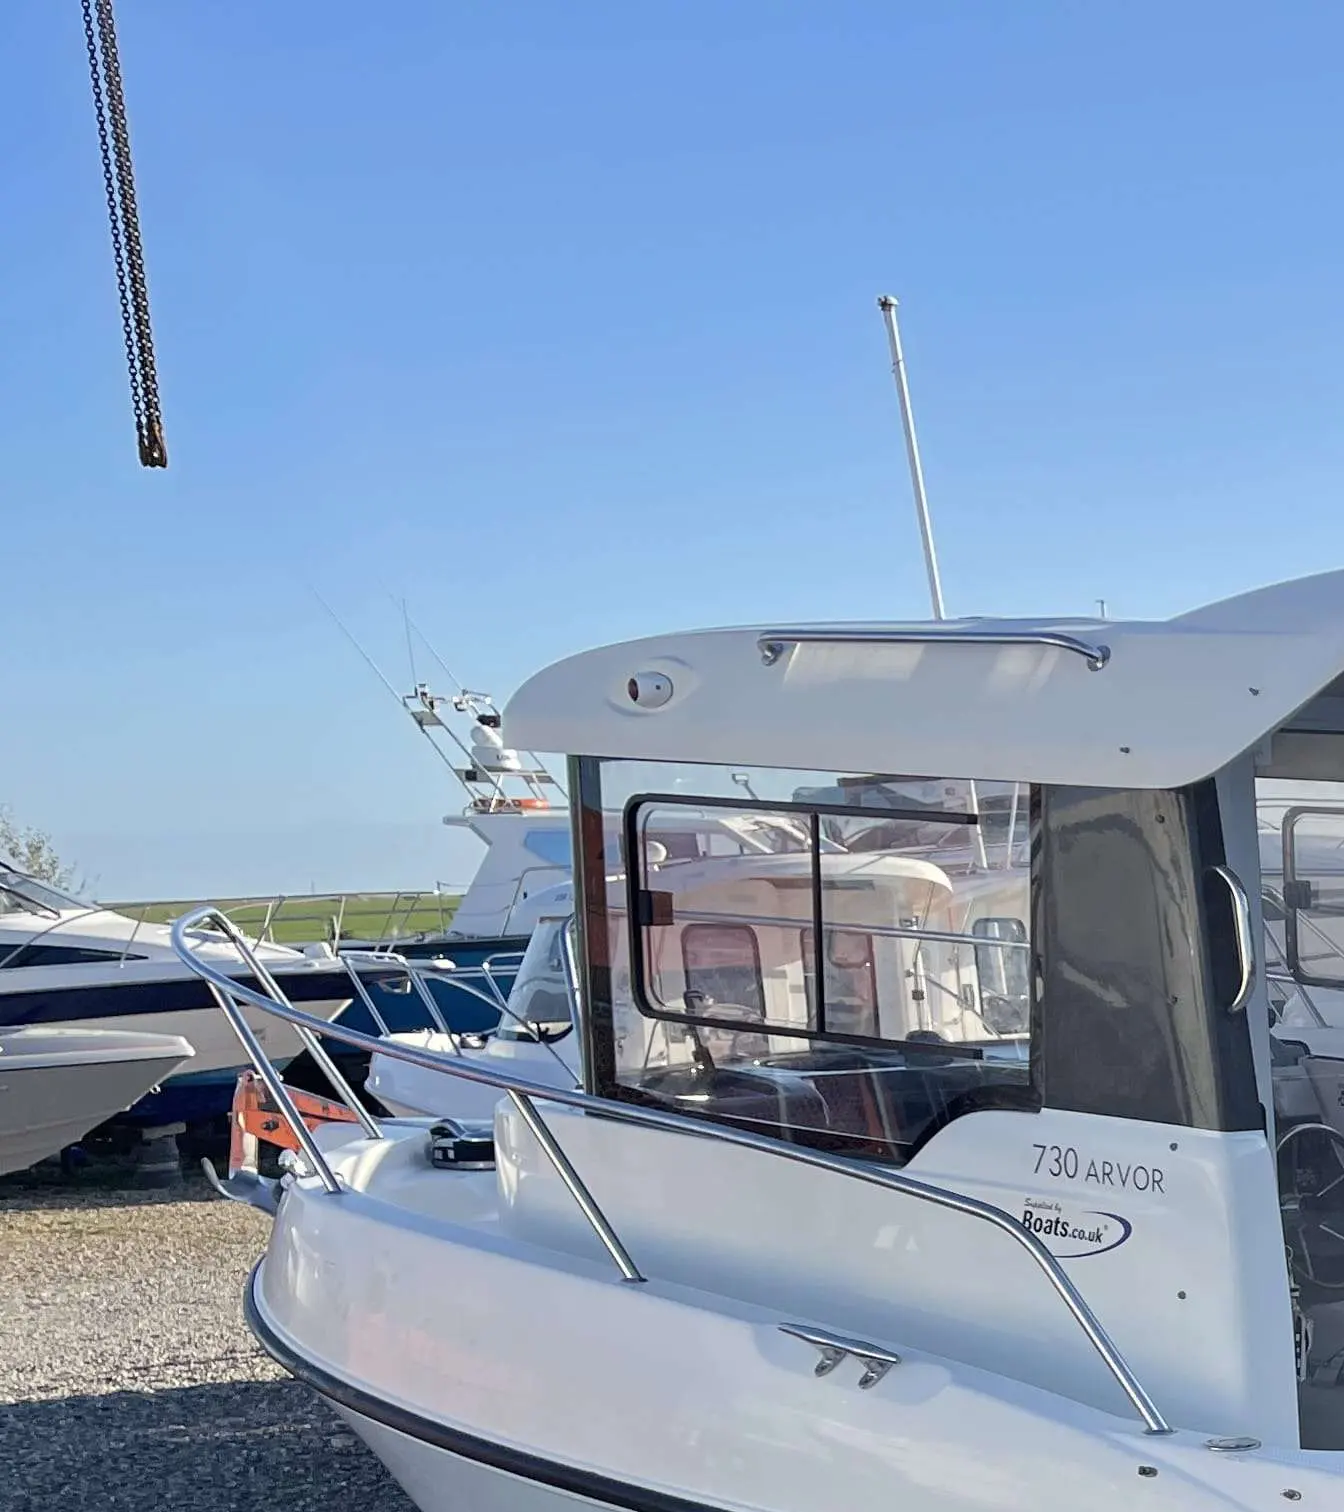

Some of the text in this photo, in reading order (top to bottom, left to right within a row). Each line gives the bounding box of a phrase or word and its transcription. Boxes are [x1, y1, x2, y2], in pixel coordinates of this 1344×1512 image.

[1033, 1143, 1166, 1194] 730 ARVOR
[1022, 1210, 1104, 1244] Boats.co.uk
